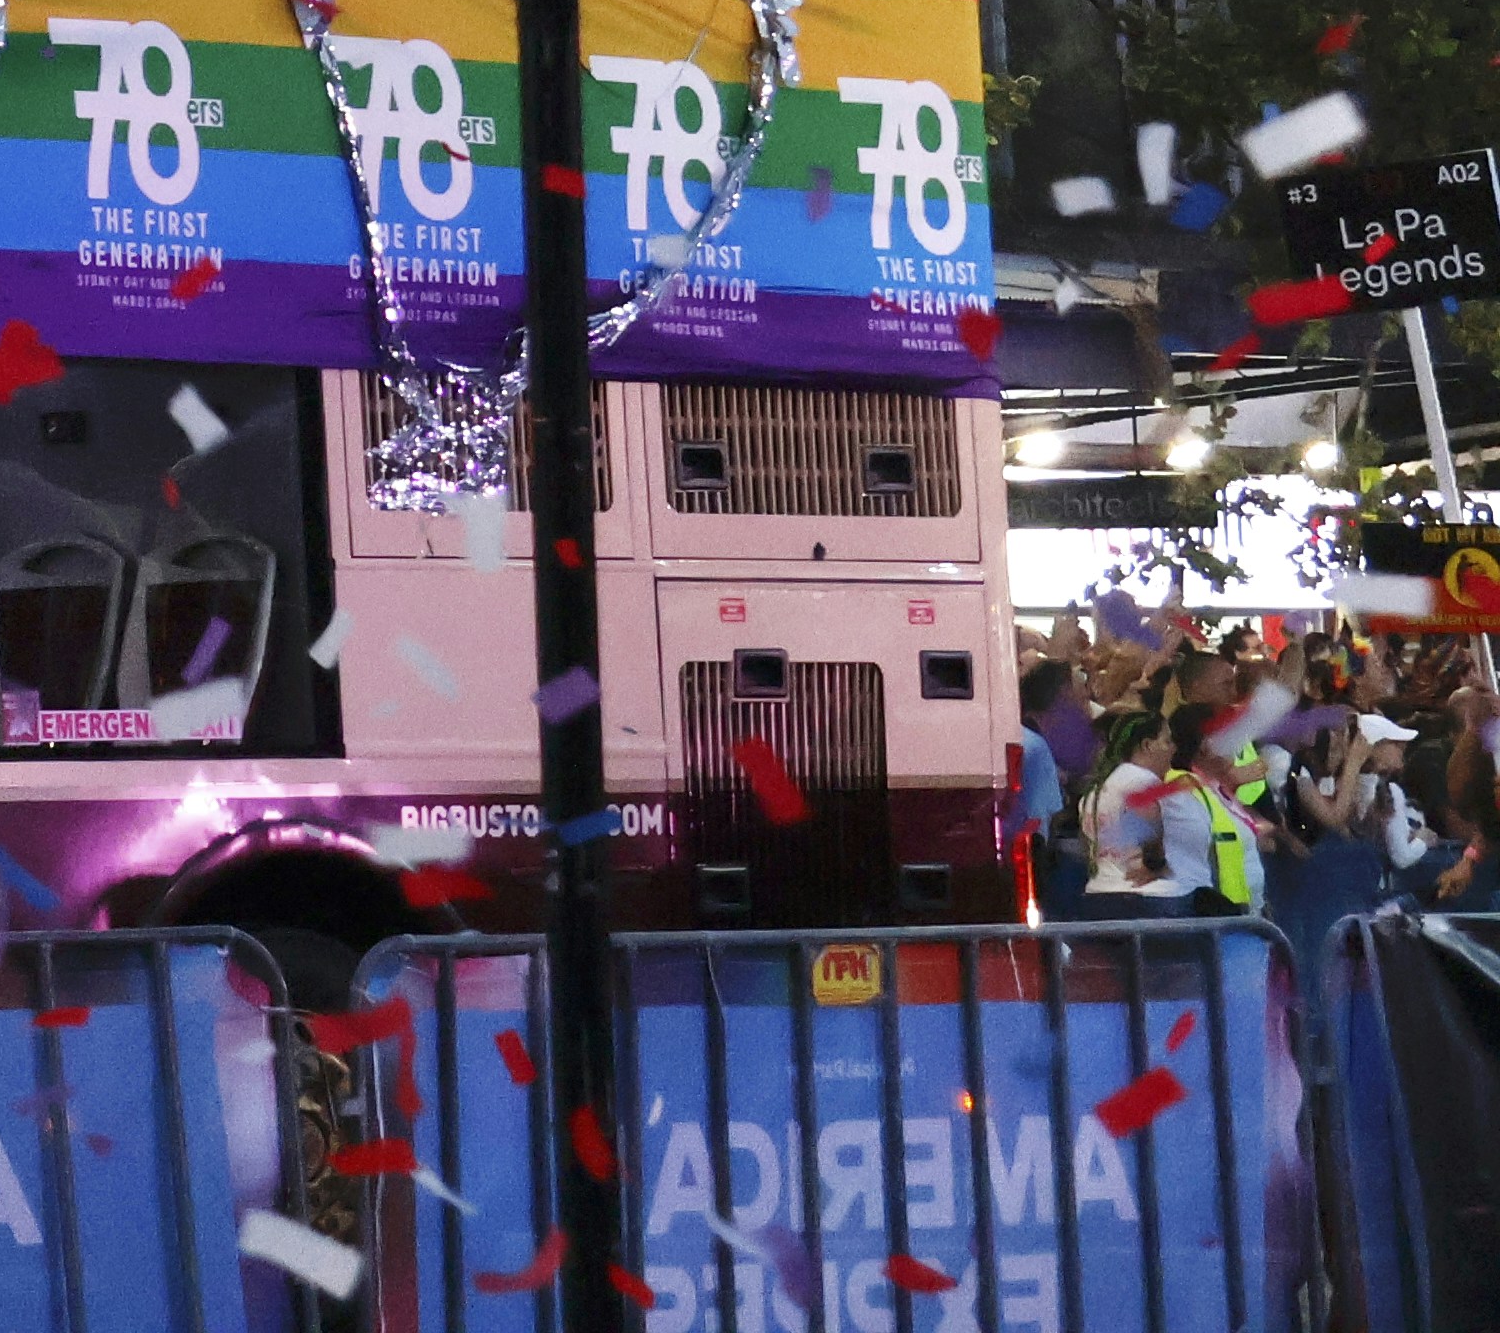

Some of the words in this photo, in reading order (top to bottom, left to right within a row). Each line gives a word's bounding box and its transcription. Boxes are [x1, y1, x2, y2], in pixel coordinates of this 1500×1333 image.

[1287, 184, 1318, 204] #3
[1437, 162, 1483, 187] A02
[90, 206, 135, 235] THE
[144, 209, 209, 239] FIRST
[415, 224, 482, 253] FIRST
[1338, 216, 1386, 250] La
[1395, 208, 1447, 242] Pa
[348, 252, 498, 287] GNERATION
[690, 243, 743, 271] IRST
[876, 255, 917, 283] THE
[922, 259, 977, 287] FIRST
[41, 712, 152, 741] EMERGEN
